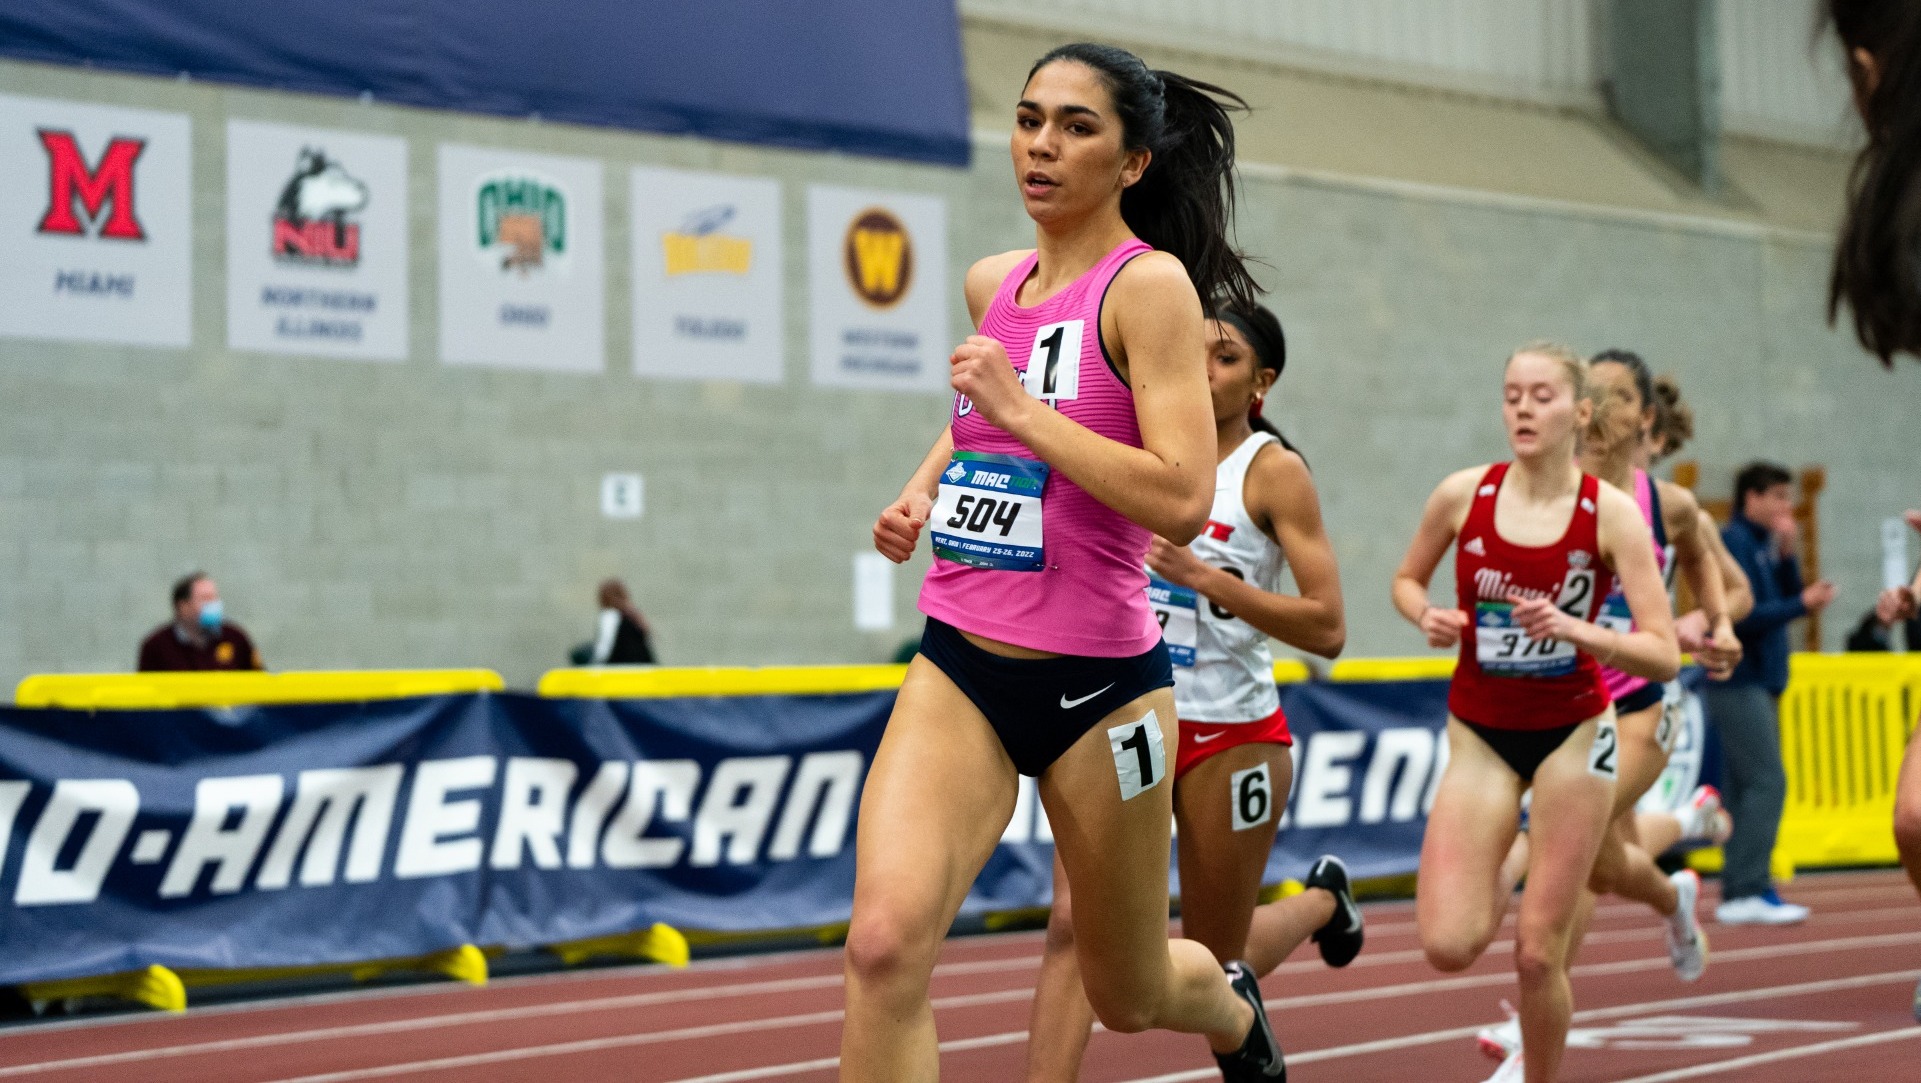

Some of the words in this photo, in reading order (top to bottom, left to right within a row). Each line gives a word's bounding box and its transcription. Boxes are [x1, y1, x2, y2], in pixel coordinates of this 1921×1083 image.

[35, 127, 149, 242] M
[272, 216, 361, 267] NIU
[853, 228, 903, 292] W
[54, 269, 135, 298] MIAMI
[1039, 326, 1065, 394] 1
[946, 494, 1022, 536] 504
[962, 542, 992, 554] FEBRUARY
[992, 547, 1014, 557] 25-26,
[1015, 550, 1035, 558] 2022
[1559, 574, 1590, 618] 2
[1121, 723, 1154, 788] 1
[1594, 726, 1616, 774] 2
[1239, 769, 1268, 823] 6
